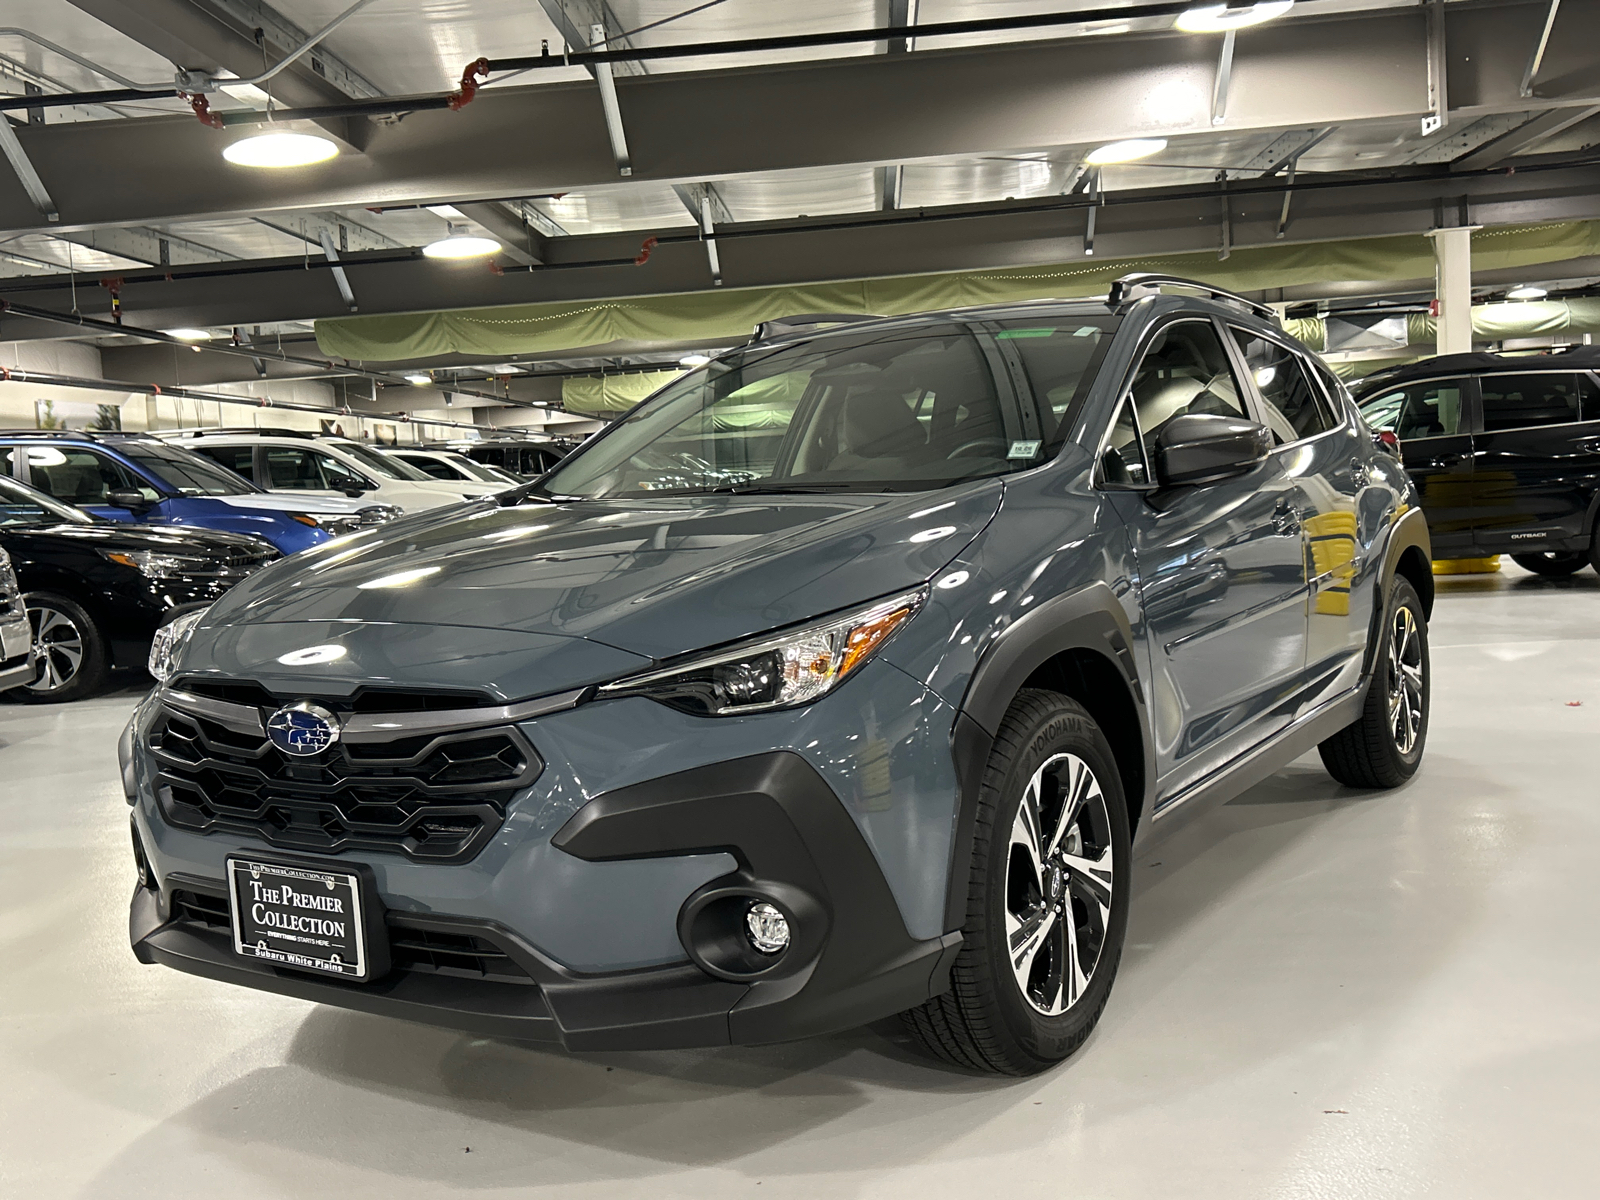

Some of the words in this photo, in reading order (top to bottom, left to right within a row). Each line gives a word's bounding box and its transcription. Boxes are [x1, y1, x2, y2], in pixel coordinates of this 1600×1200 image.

[1511, 532, 1547, 540] OUTBACK
[1030, 717, 1083, 757] YOKOHAMA
[249, 880, 281, 904] THE
[281, 885, 344, 913] PREMIER
[251, 903, 345, 938] COLLECTION
[255, 948, 285, 960] Subaru
[287, 955, 312, 966] White
[315, 960, 343, 972] Plains
